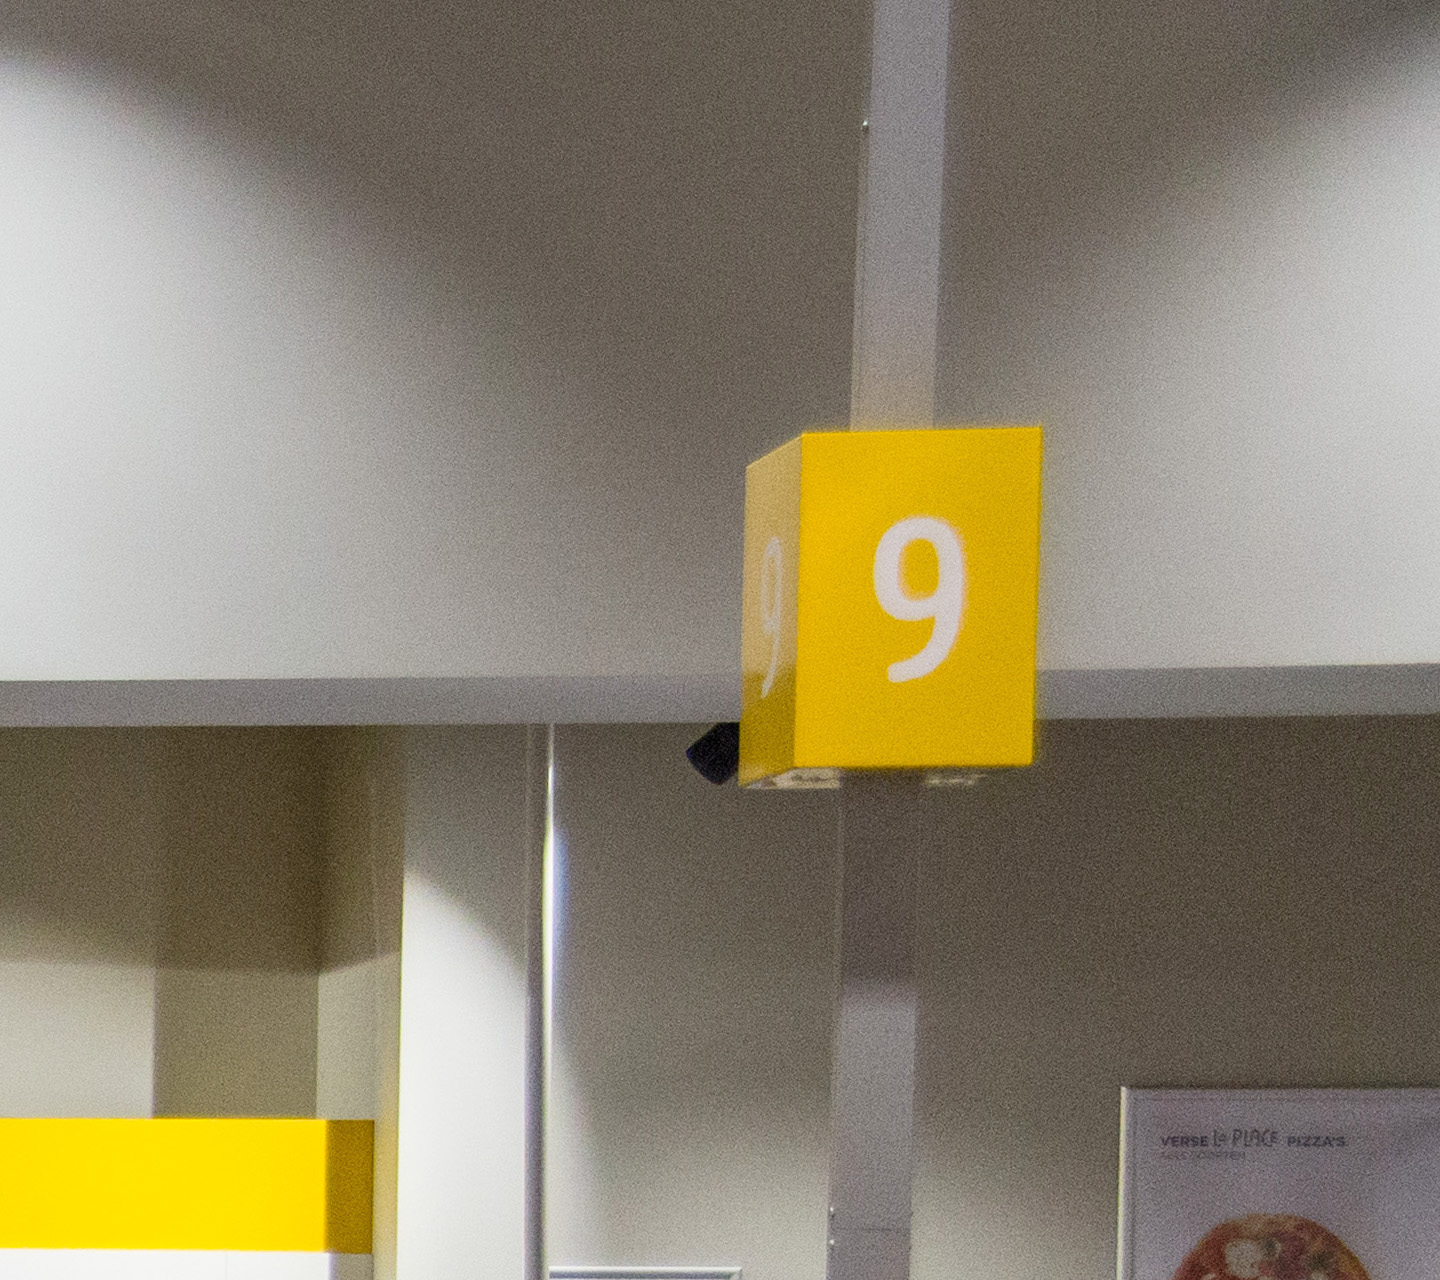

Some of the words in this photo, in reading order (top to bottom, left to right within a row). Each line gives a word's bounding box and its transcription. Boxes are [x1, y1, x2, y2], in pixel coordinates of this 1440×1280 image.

[873, 515, 965, 683] 9
[1161, 1135, 1209, 1148] VERSE
[1231, 1128, 1279, 1148] PLACE
[1287, 1135, 1347, 1148] PIZZA'S
